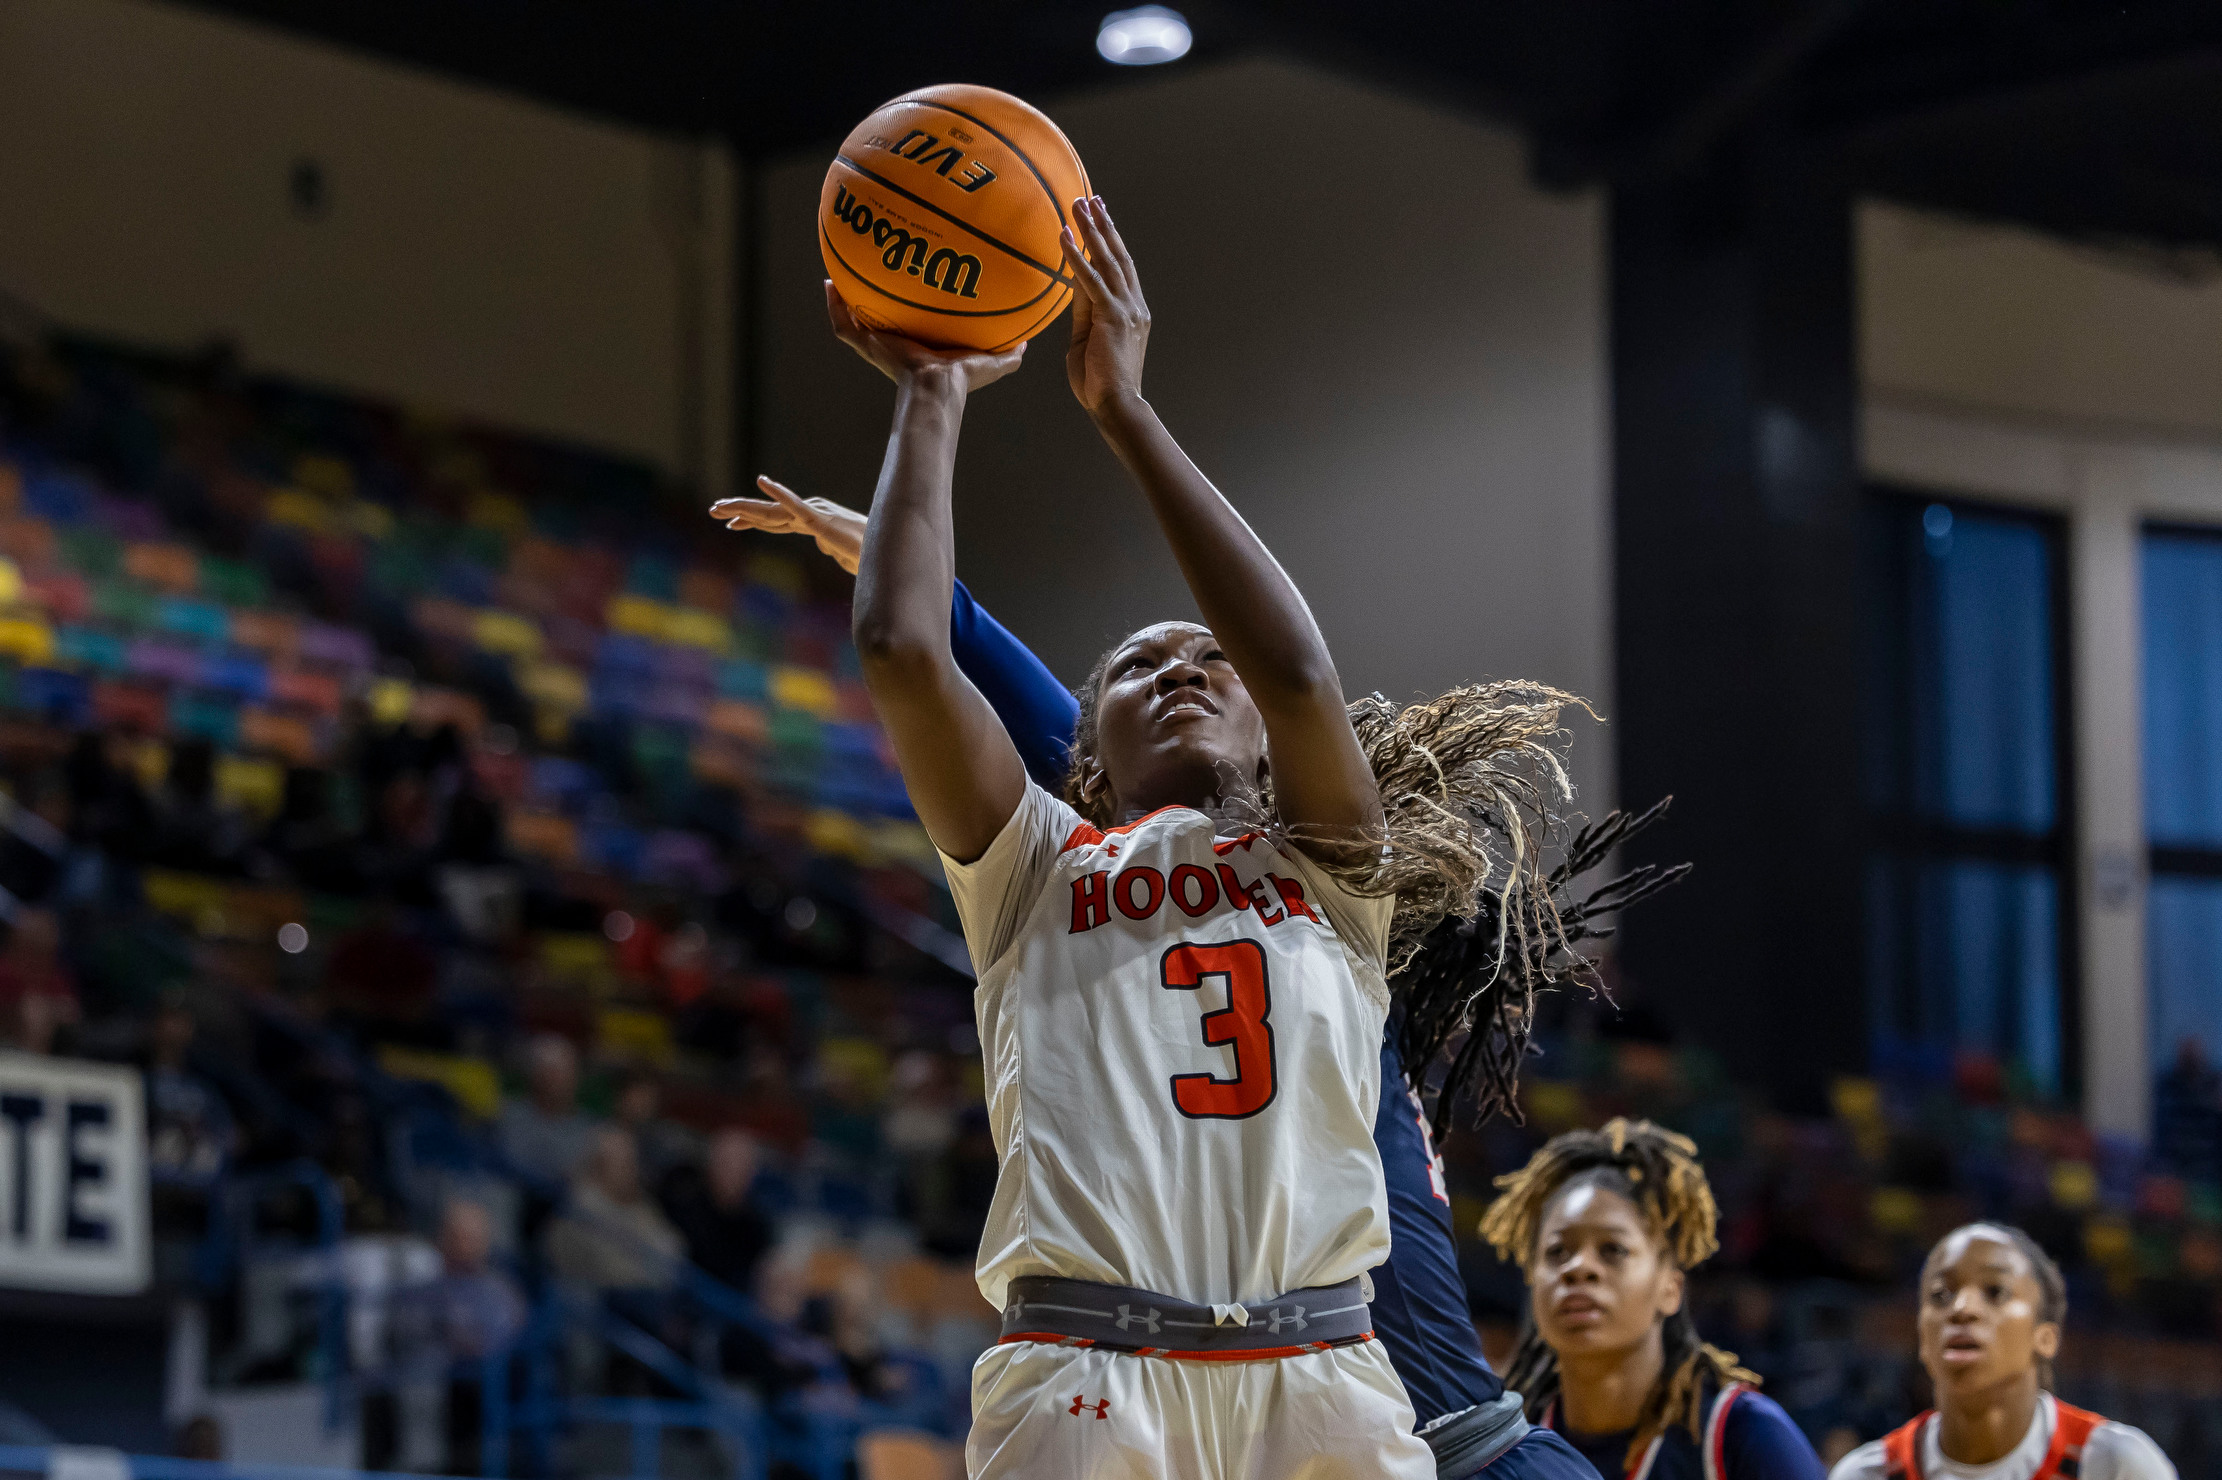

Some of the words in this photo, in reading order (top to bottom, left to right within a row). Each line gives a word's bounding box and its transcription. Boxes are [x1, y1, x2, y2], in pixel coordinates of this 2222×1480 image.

[889, 129, 997, 193] EVO
[833, 182, 983, 299] Wilson
[1160, 938, 1277, 1119] 3
